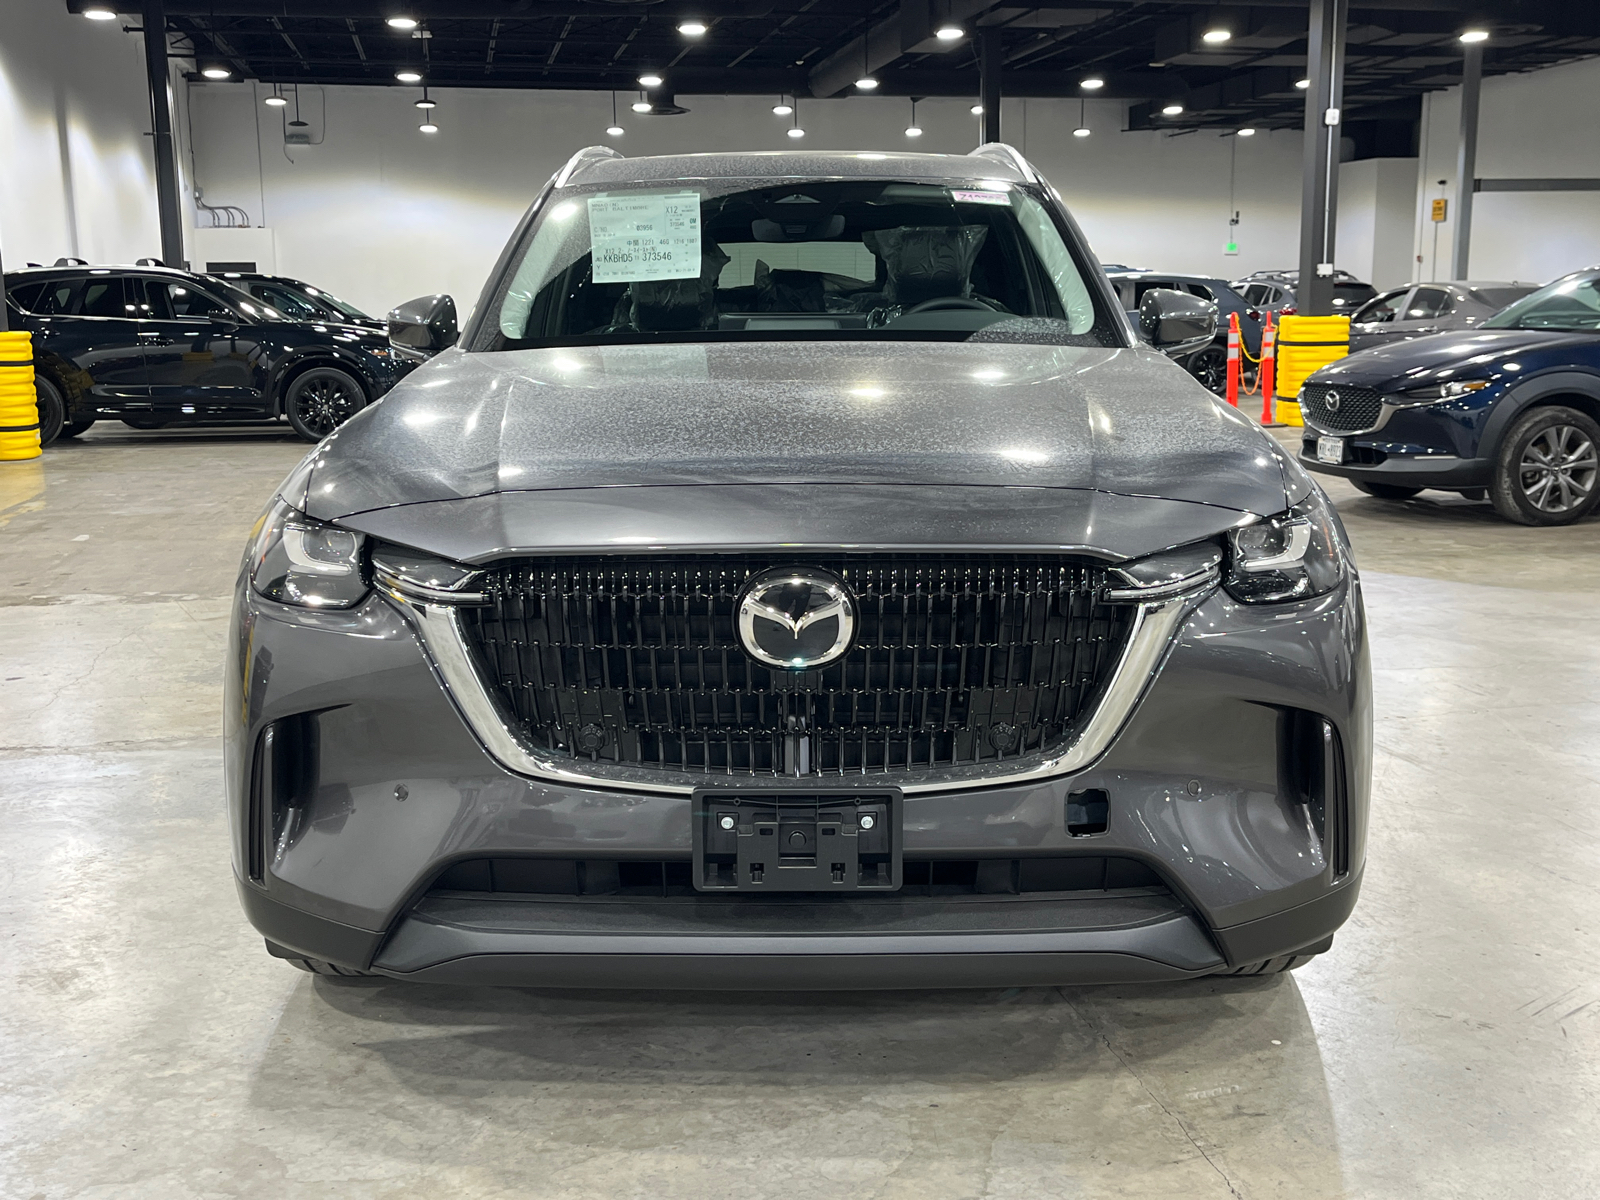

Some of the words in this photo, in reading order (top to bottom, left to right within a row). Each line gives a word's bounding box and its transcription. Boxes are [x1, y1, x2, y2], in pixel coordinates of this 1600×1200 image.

[665, 206, 678, 214] X12
[603, 253, 633, 263] KKBHD5
[642, 252, 672, 262] 373546
